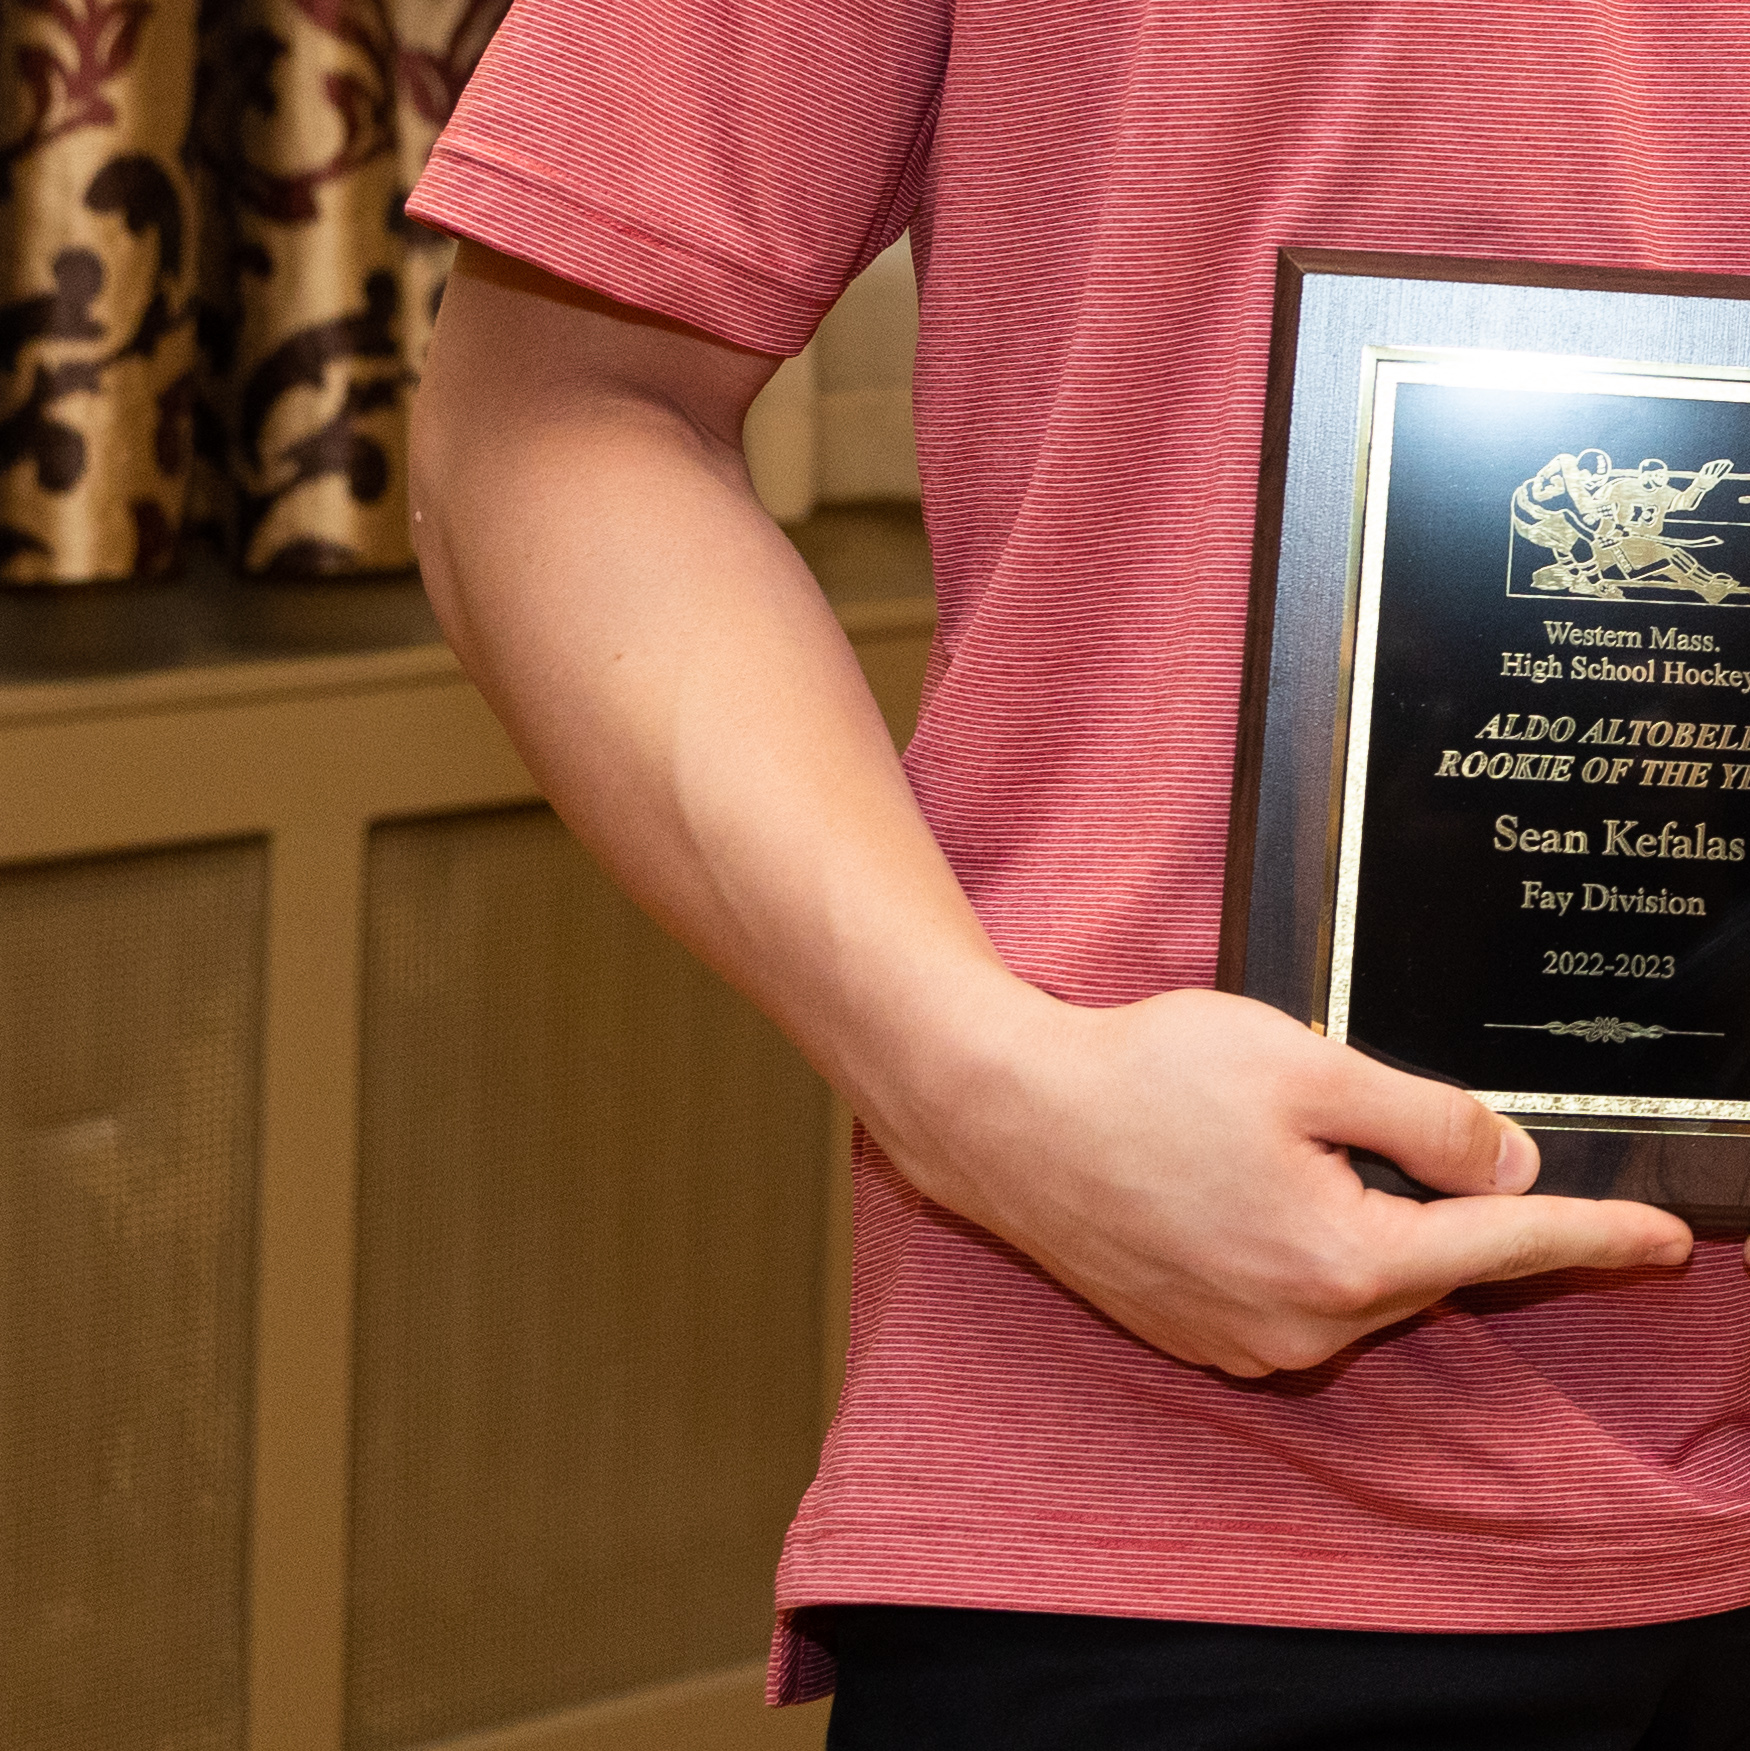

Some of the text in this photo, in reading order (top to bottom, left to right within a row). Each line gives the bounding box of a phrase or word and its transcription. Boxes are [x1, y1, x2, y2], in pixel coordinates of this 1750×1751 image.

[1543, 621, 1720, 652] Western Mass.
[1500, 652, 1563, 683] High
[1571, 656, 1654, 682] School
[1475, 714, 1576, 742] ALDO
[1434, 750, 1575, 781] ROOKIE
[1582, 757, 1633, 784] OF
[1639, 759, 1712, 787] THE
[1494, 815, 1744, 861] Sean Kefalas
[1521, 881, 1706, 916] Fay Division
[1542, 951, 1675, 979] 2022-2023
